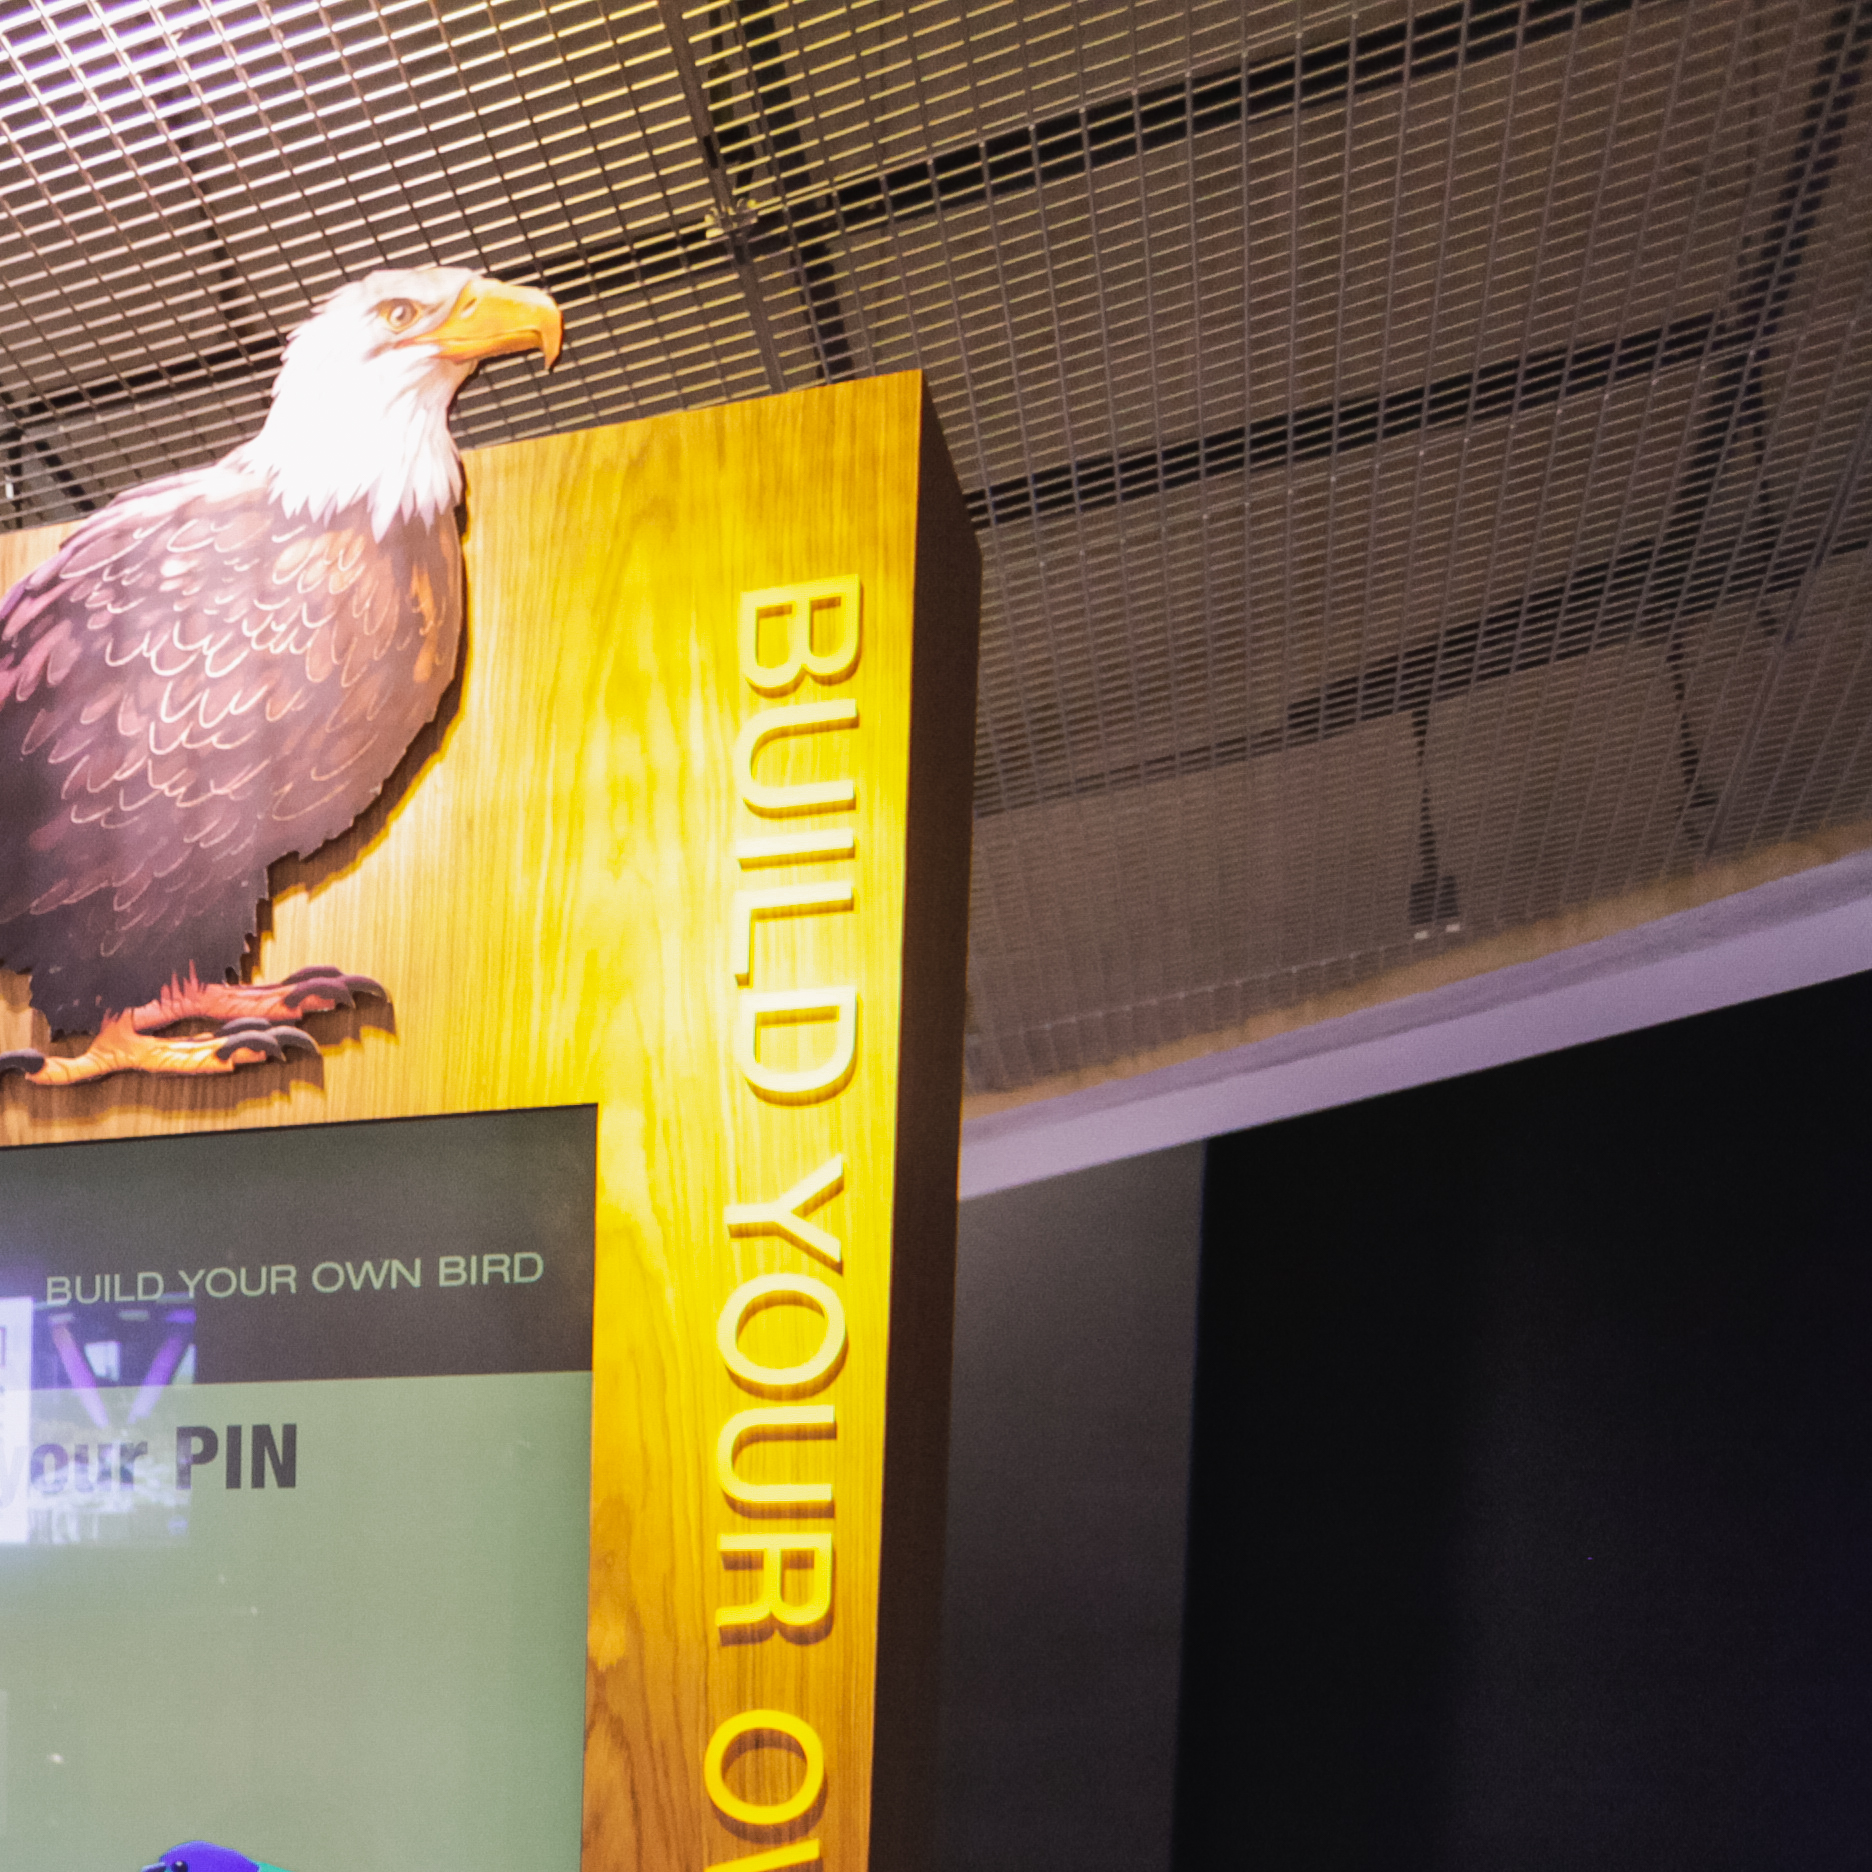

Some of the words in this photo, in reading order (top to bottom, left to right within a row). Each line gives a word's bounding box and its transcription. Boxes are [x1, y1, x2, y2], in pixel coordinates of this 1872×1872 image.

[734, 573, 862, 1101] BUILD
[45, 1271, 165, 1305] BUILD
[178, 1264, 297, 1300] YOUR
[311, 1257, 422, 1293] OWN
[438, 1251, 545, 1288] BIRD
[715, 1154, 847, 1638] YOUR
[174, 1423, 297, 1490] PIN
